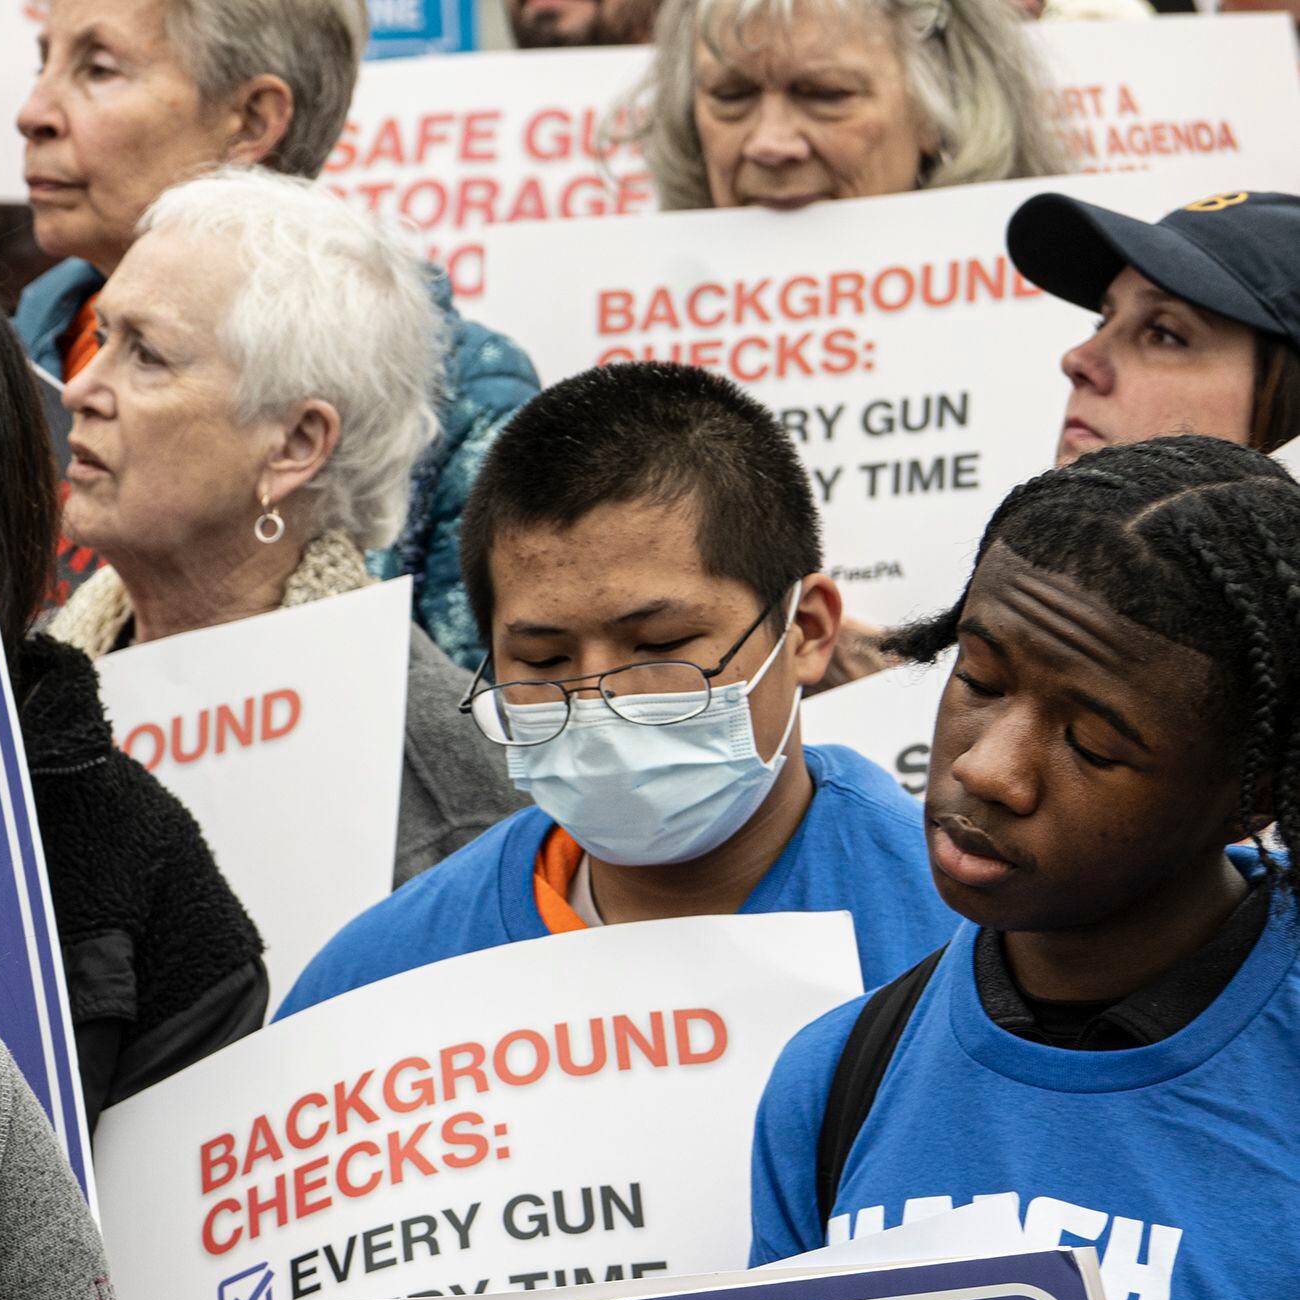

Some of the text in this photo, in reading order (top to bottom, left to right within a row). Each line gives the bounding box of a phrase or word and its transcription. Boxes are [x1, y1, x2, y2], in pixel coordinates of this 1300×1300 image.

[324, 105, 647, 173] SAFE GU
[1105, 118, 1241, 158] AGENDA
[326, 171, 654, 230] TORAGE
[861, 391, 971, 438] GUN
[860, 453, 982, 500] TIME
[200, 1007, 729, 1194] BACKGROUND
[201, 1111, 512, 1257] CHECKS:
[290, 1202, 482, 1300] EVERY
[502, 1181, 647, 1241] GUN
